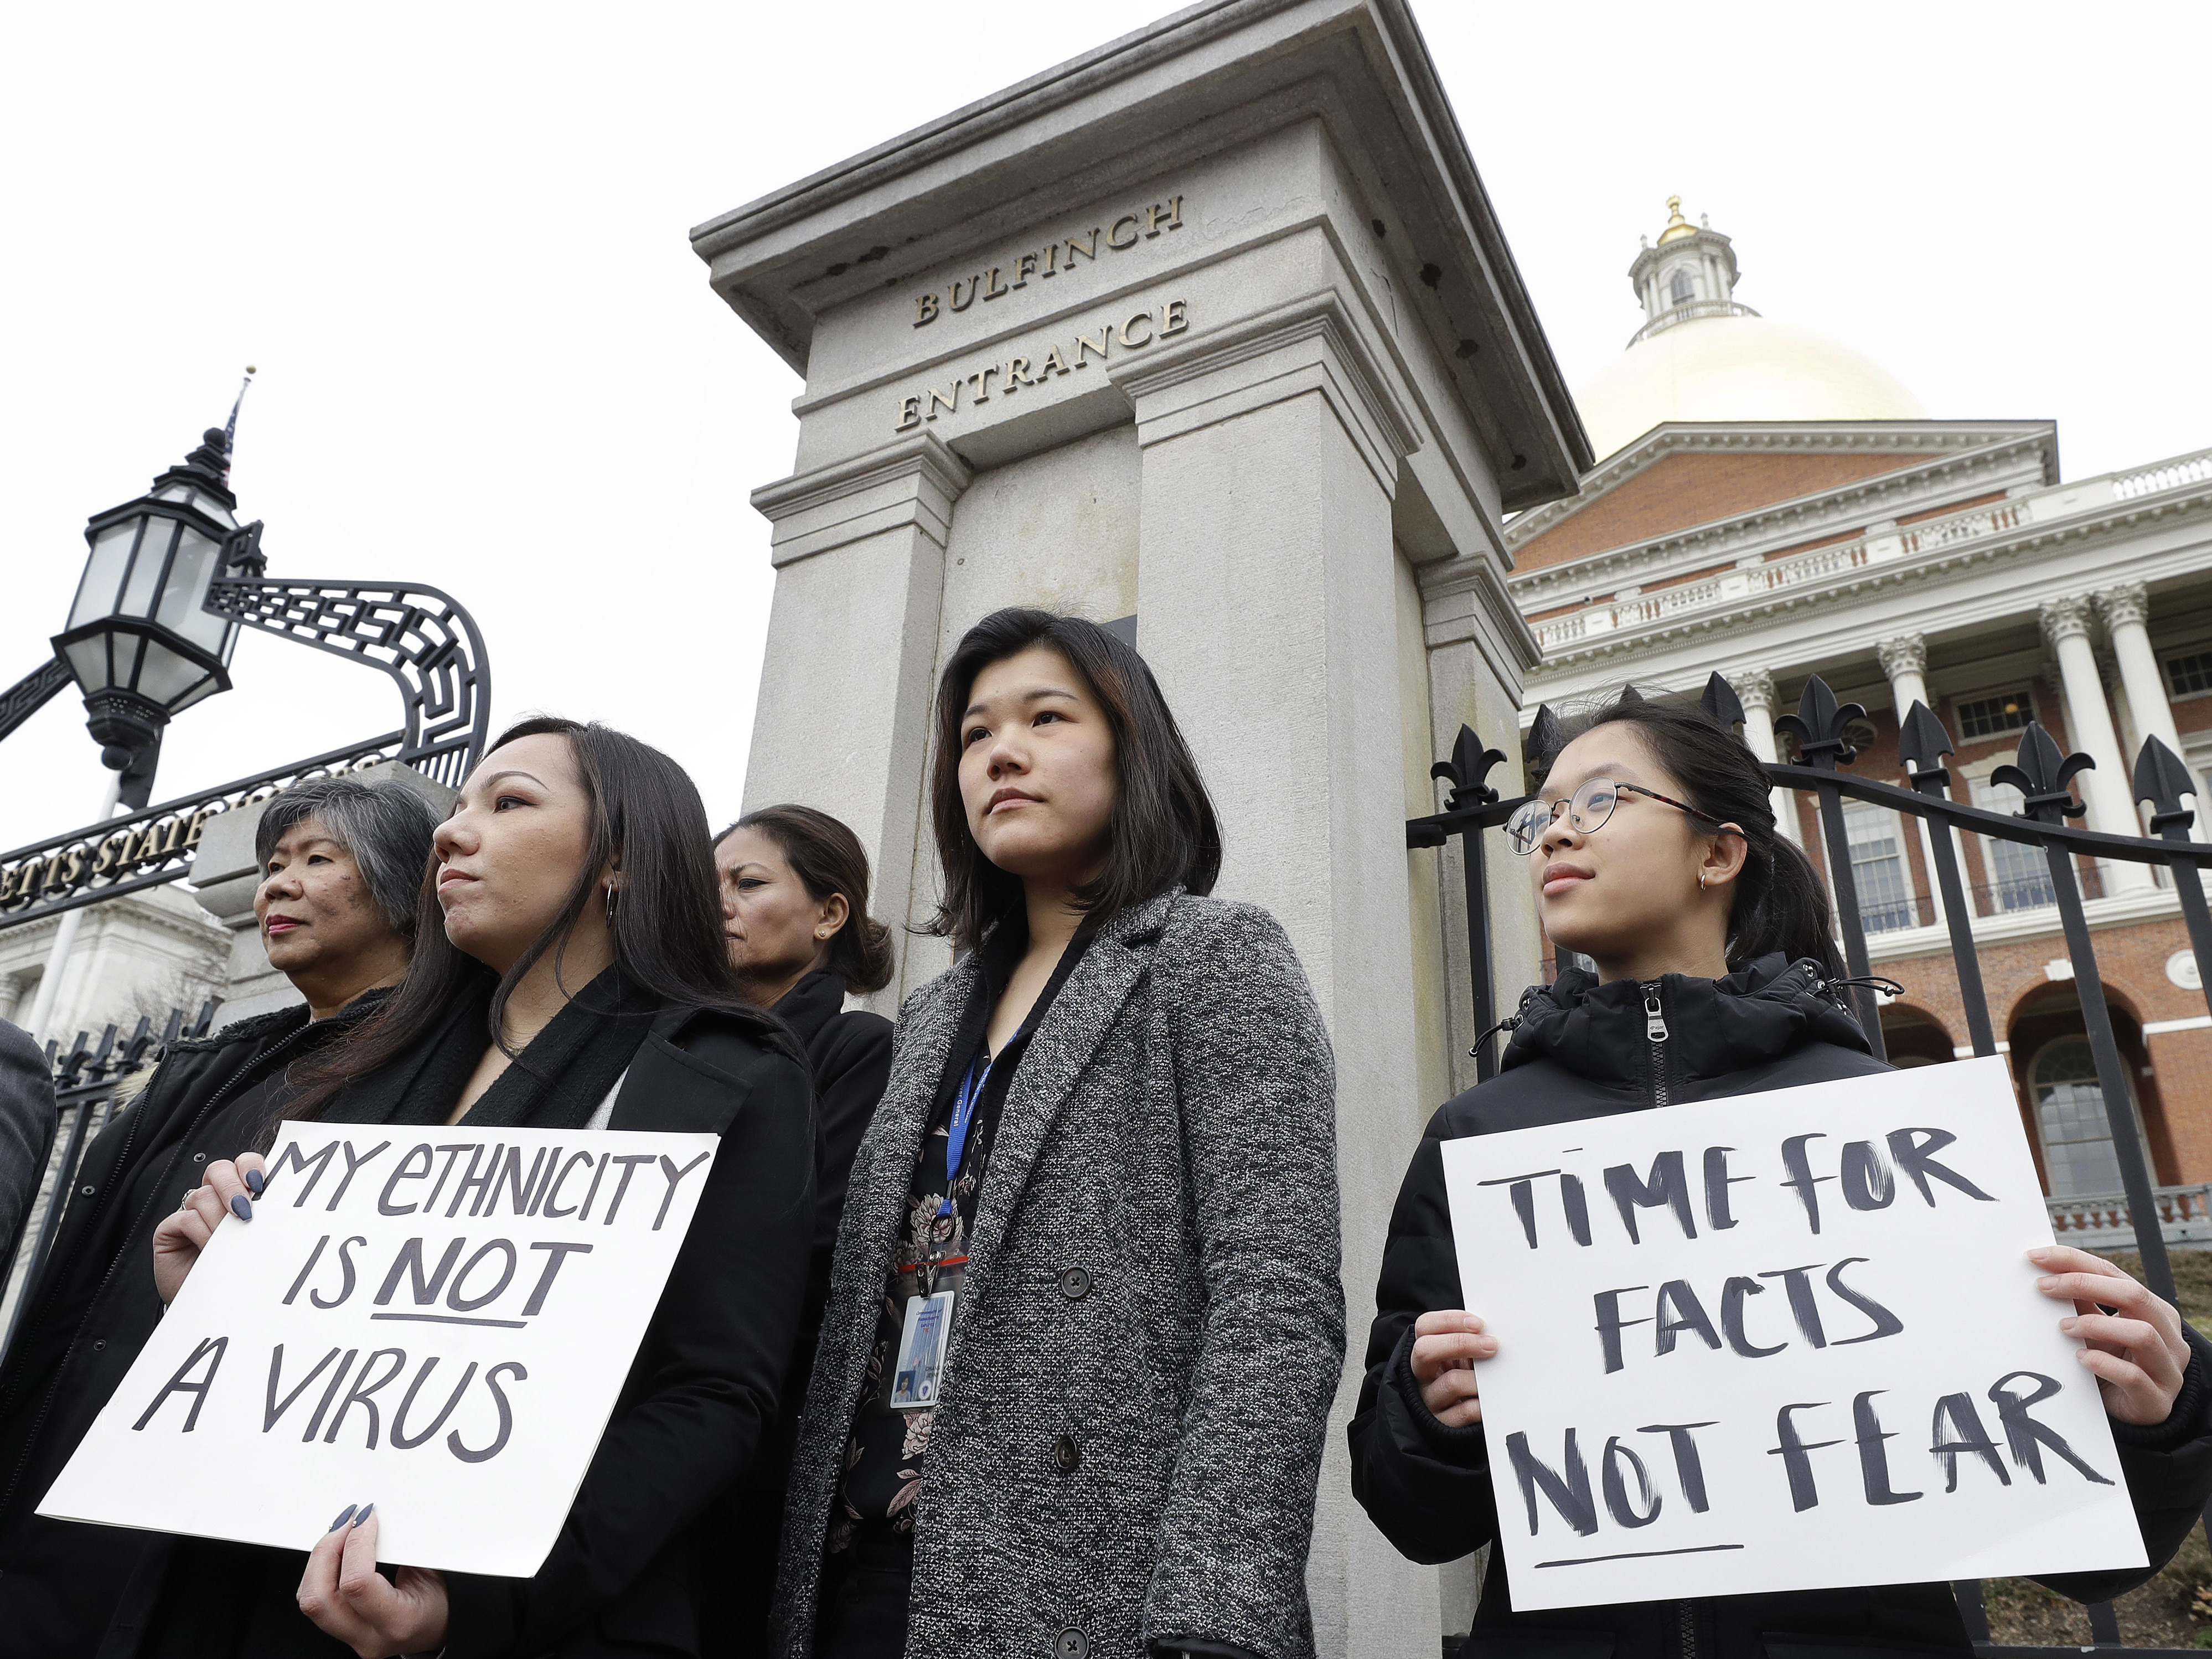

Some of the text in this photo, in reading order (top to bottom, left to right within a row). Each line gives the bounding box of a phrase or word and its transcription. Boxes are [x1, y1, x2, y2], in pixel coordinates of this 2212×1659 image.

[913, 195, 1183, 328] BULFINCH
[894, 298, 1189, 432] ENTRANCE
[92, 810, 213, 873] STATE
[953, 1099, 962, 1126] General
[252, 1141, 391, 1211] MY
[1780, 1128, 1999, 1235] FOR
[282, 1236, 593, 1316] IS NOT
[1594, 1258, 1904, 1374] FACTS
[132, 1337, 528, 1462] A VIRUS
[1506, 1371, 2116, 1537] NOT FEAR
